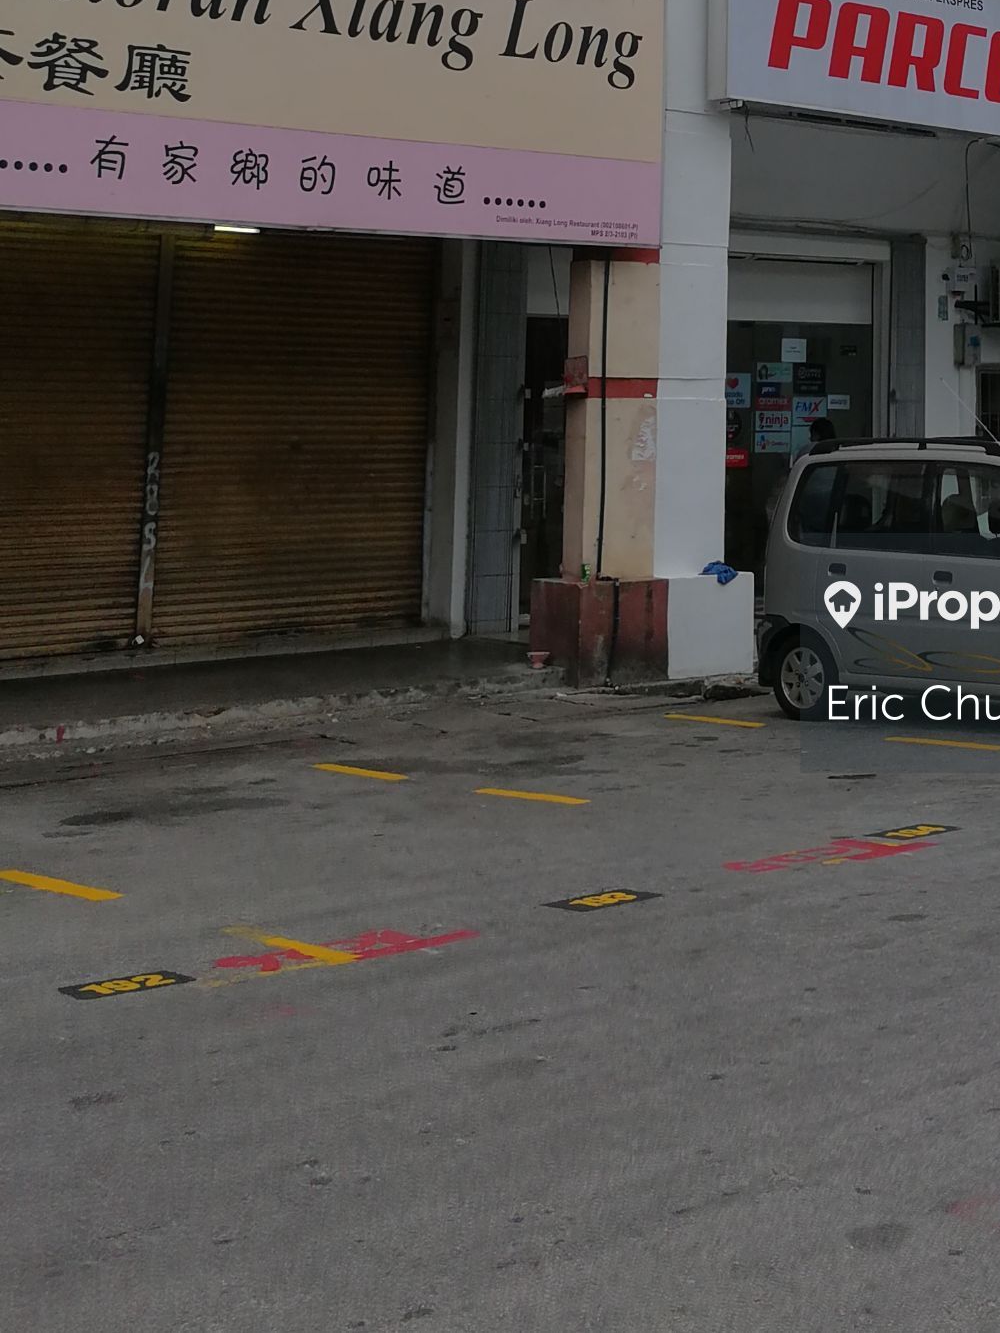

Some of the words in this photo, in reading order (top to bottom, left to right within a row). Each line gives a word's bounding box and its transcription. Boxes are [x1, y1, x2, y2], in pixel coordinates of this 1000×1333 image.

[535, 218, 552, 227] Xiang
[553, 219, 568, 228] Long
[569, 219, 600, 229] Restaurant
[795, 395, 824, 415] FMX
[765, 413, 789, 428] ninja
[78, 972, 176, 996] 192
